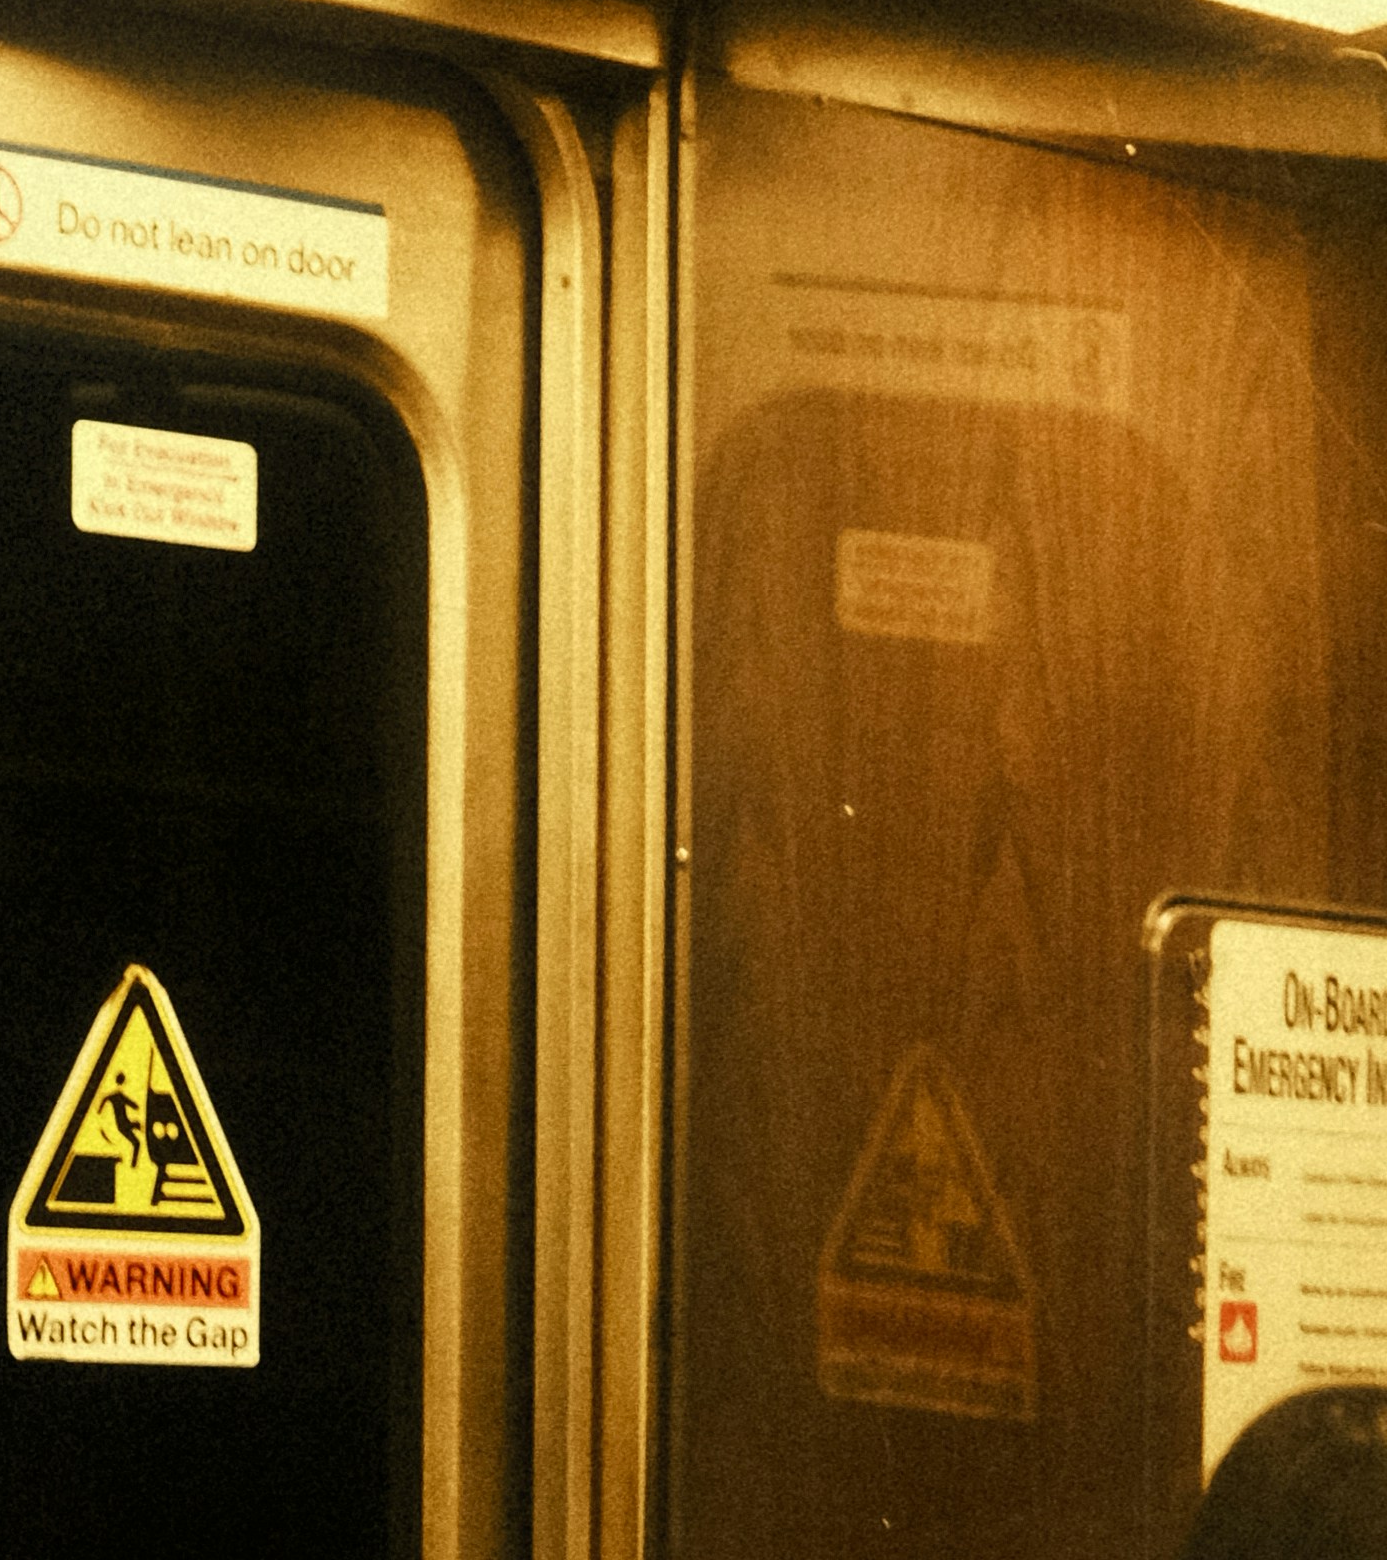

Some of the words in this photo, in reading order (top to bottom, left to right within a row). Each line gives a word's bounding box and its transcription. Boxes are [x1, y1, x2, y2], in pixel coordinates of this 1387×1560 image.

[57, 201, 101, 240] Do
[110, 217, 160, 251] not
[169, 219, 233, 261] lean
[241, 241, 279, 267] on
[287, 242, 357, 282] door
[1283, 969, 1387, 1038] ON-BOAR
[66, 1257, 241, 1300] WARNING
[17, 1309, 119, 1346] Watch
[127, 1314, 178, 1349] the
[185, 1315, 249, 1359] Gap
